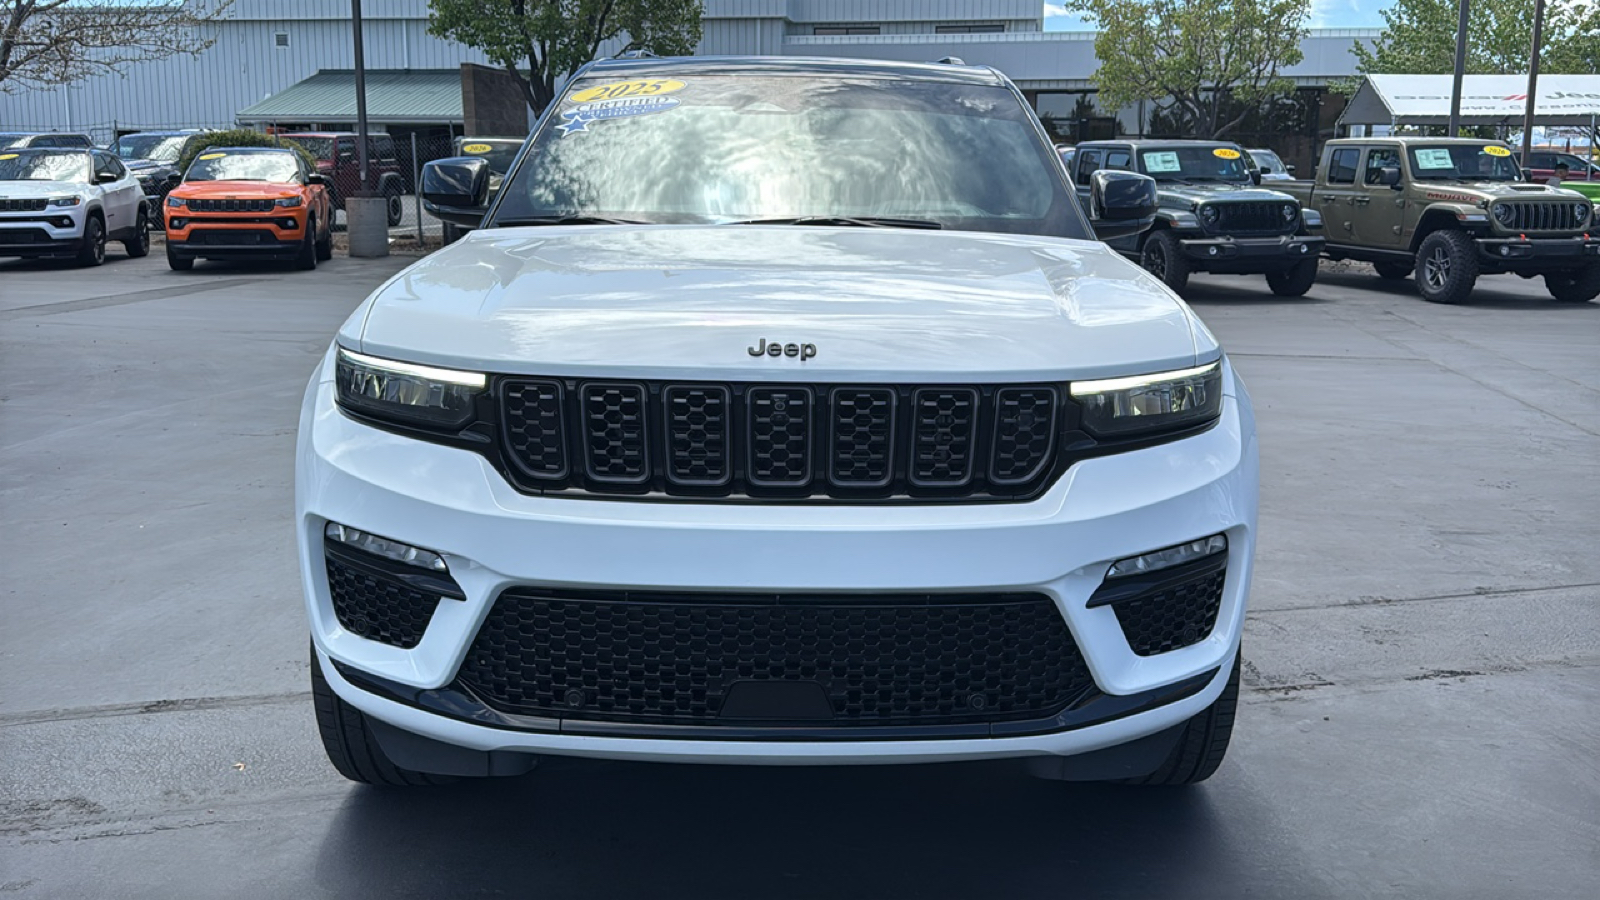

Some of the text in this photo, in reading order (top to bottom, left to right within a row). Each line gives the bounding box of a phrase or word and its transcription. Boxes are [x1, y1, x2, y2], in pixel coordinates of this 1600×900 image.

[586, 80, 669, 101] 2025
[576, 97, 669, 111] CERTIFIED
[747, 338, 817, 361] Jeep
